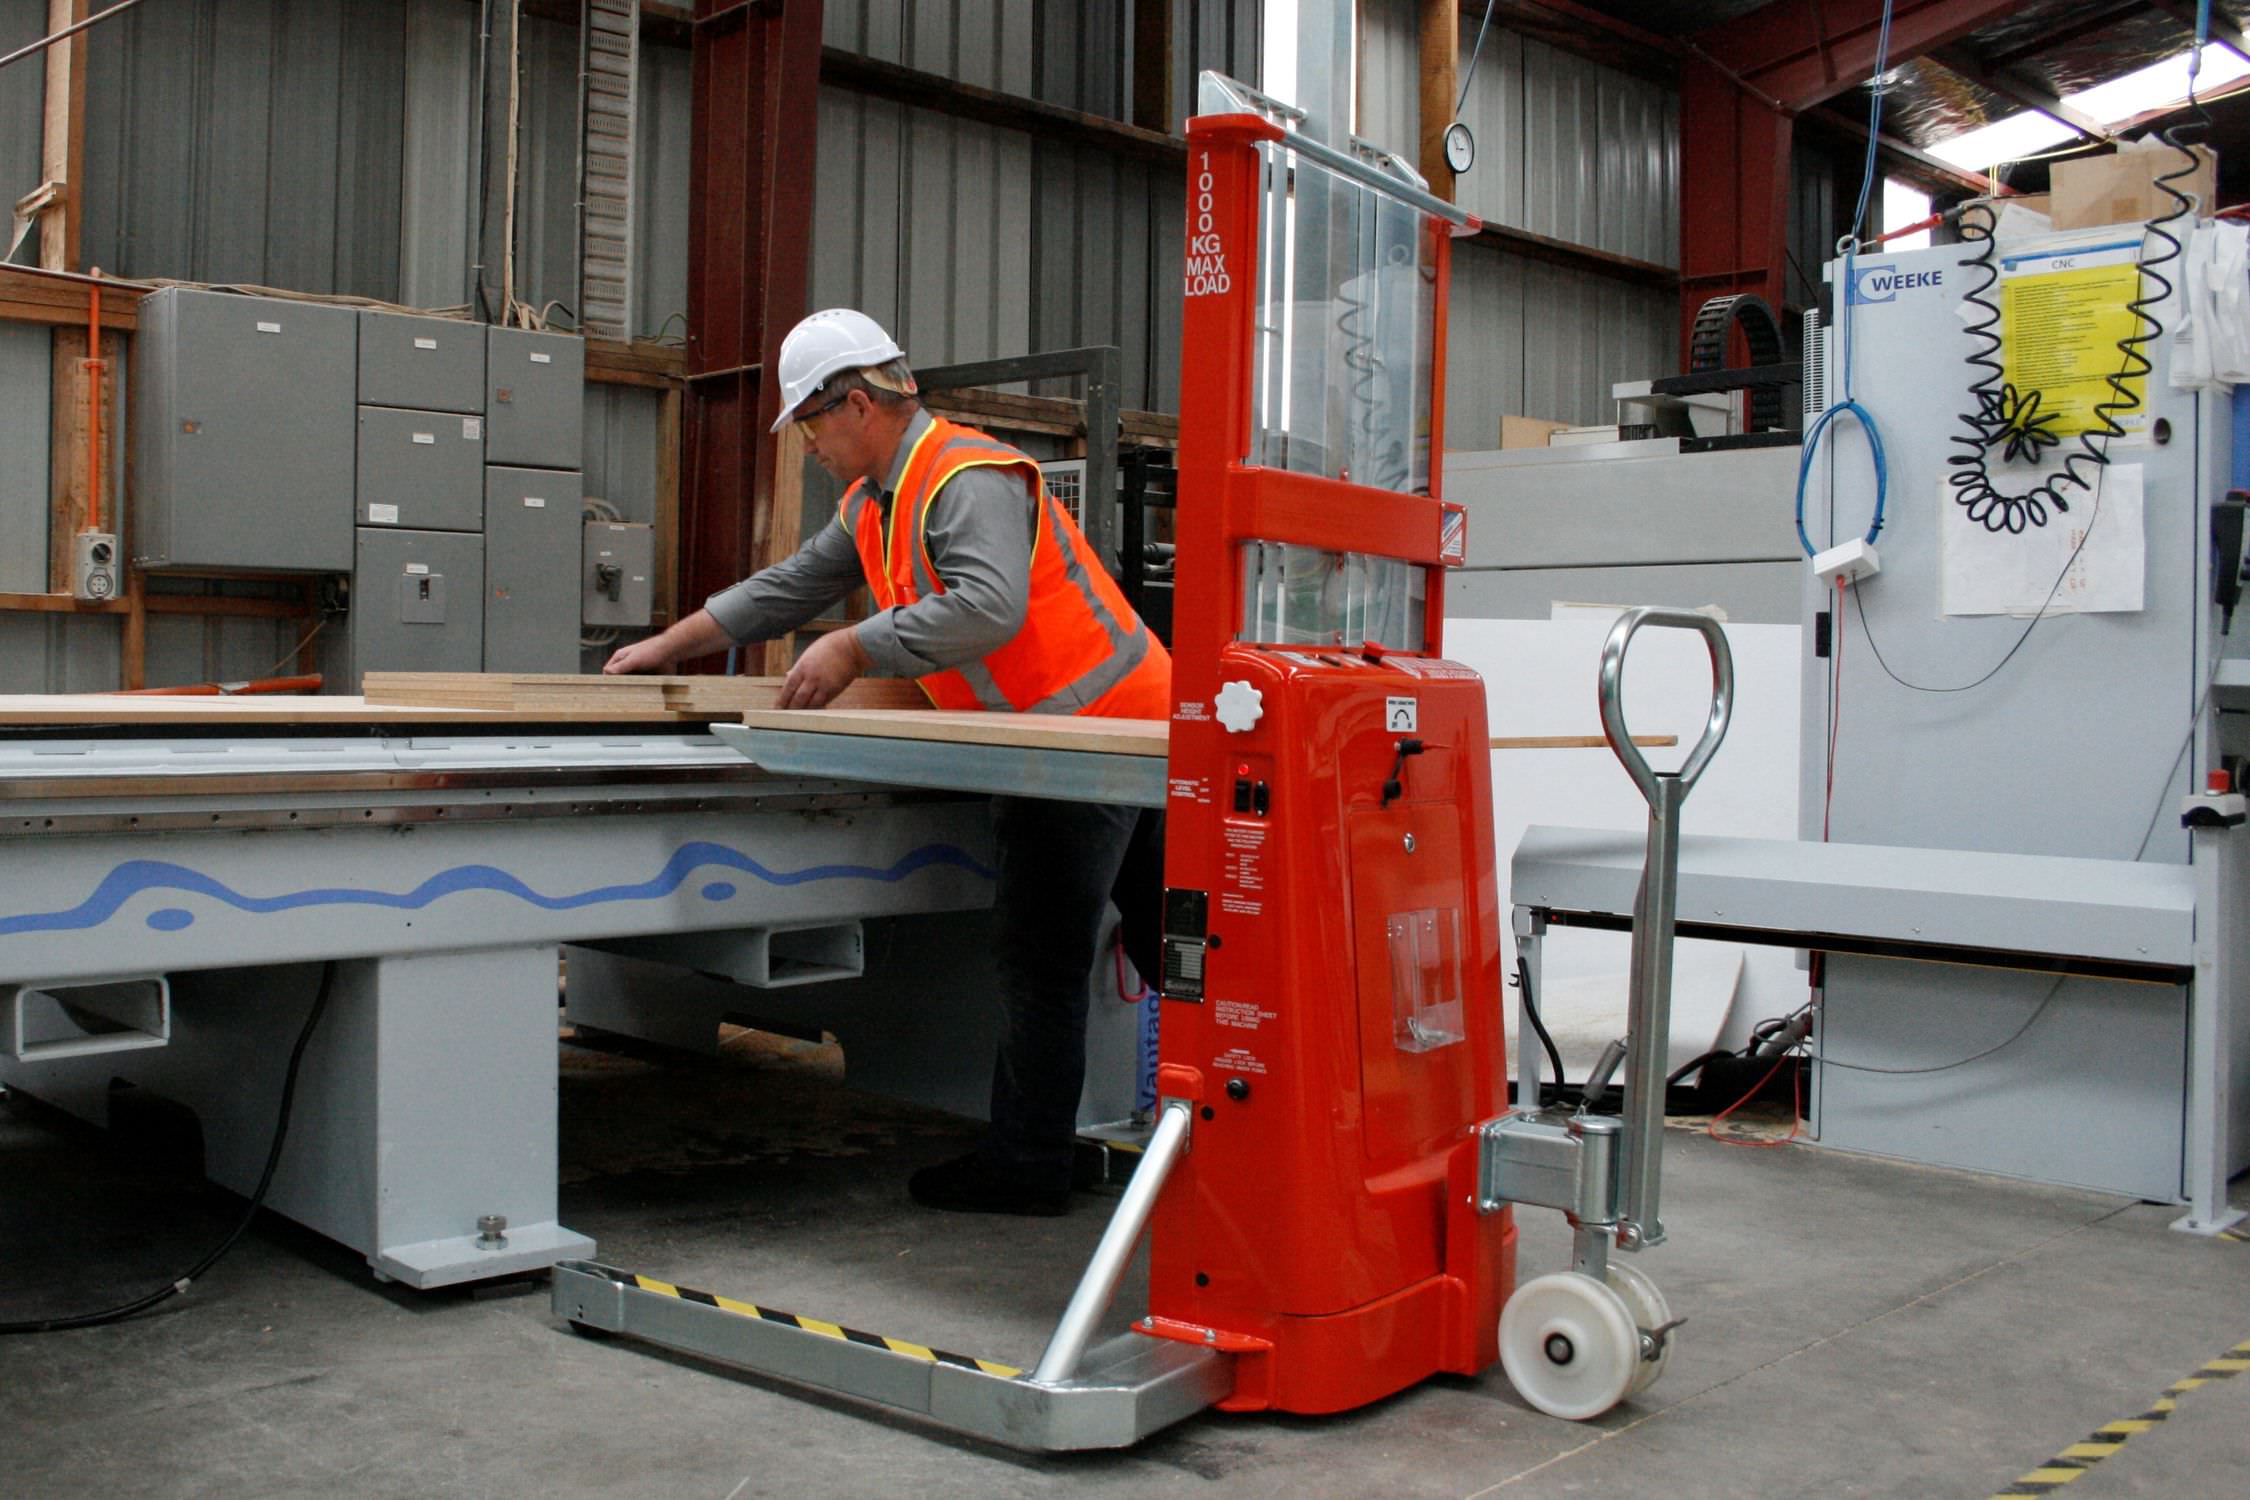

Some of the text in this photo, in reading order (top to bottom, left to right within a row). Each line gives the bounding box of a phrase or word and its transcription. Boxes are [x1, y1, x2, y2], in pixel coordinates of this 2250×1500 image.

[1191, 233, 1221, 256] KG
[1186, 254, 1225, 277] MAX
[2051, 258, 2076, 270] CNC
[1184, 273, 1231, 297] LOAD
[1872, 270, 1943, 292] WEEKE
